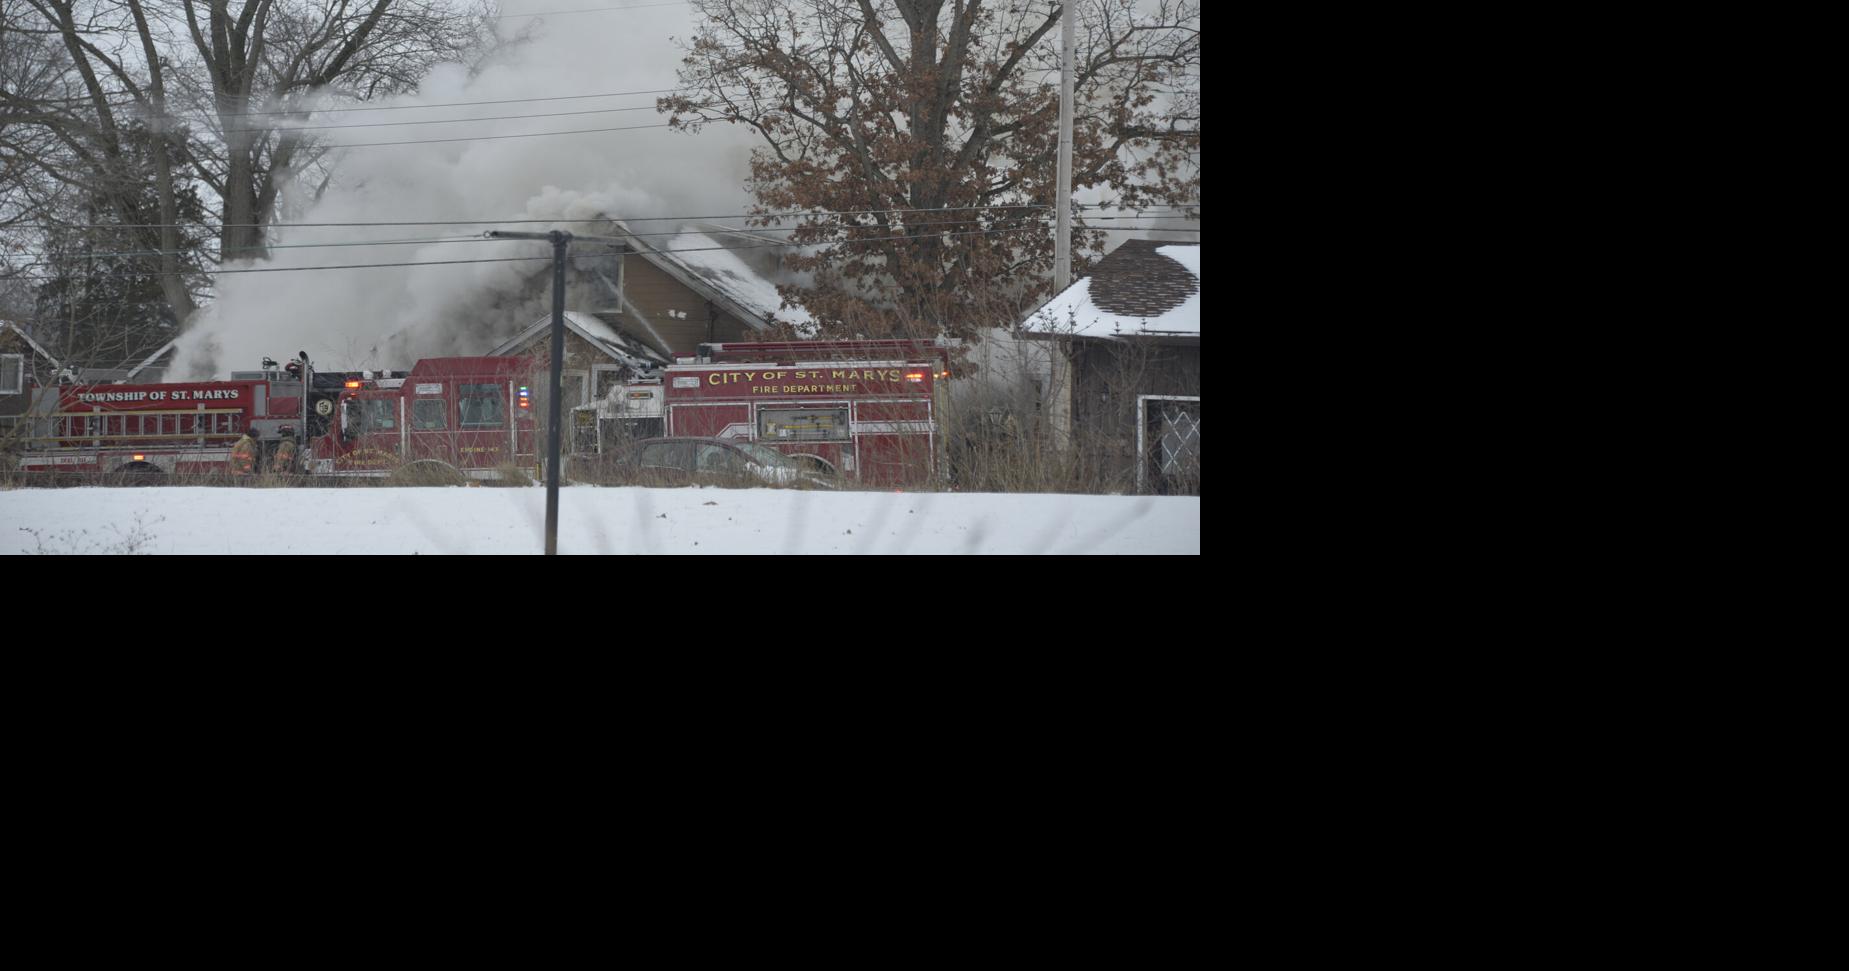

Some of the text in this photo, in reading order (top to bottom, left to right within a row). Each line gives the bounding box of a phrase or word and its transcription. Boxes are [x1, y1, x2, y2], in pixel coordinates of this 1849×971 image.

[708, 369, 900, 385] CITY OF ST. MARYS
[77, 389, 239, 402] TOWNSHIP OF ST. MARYS
[752, 384, 857, 394] FIRE DEPARTMENT
